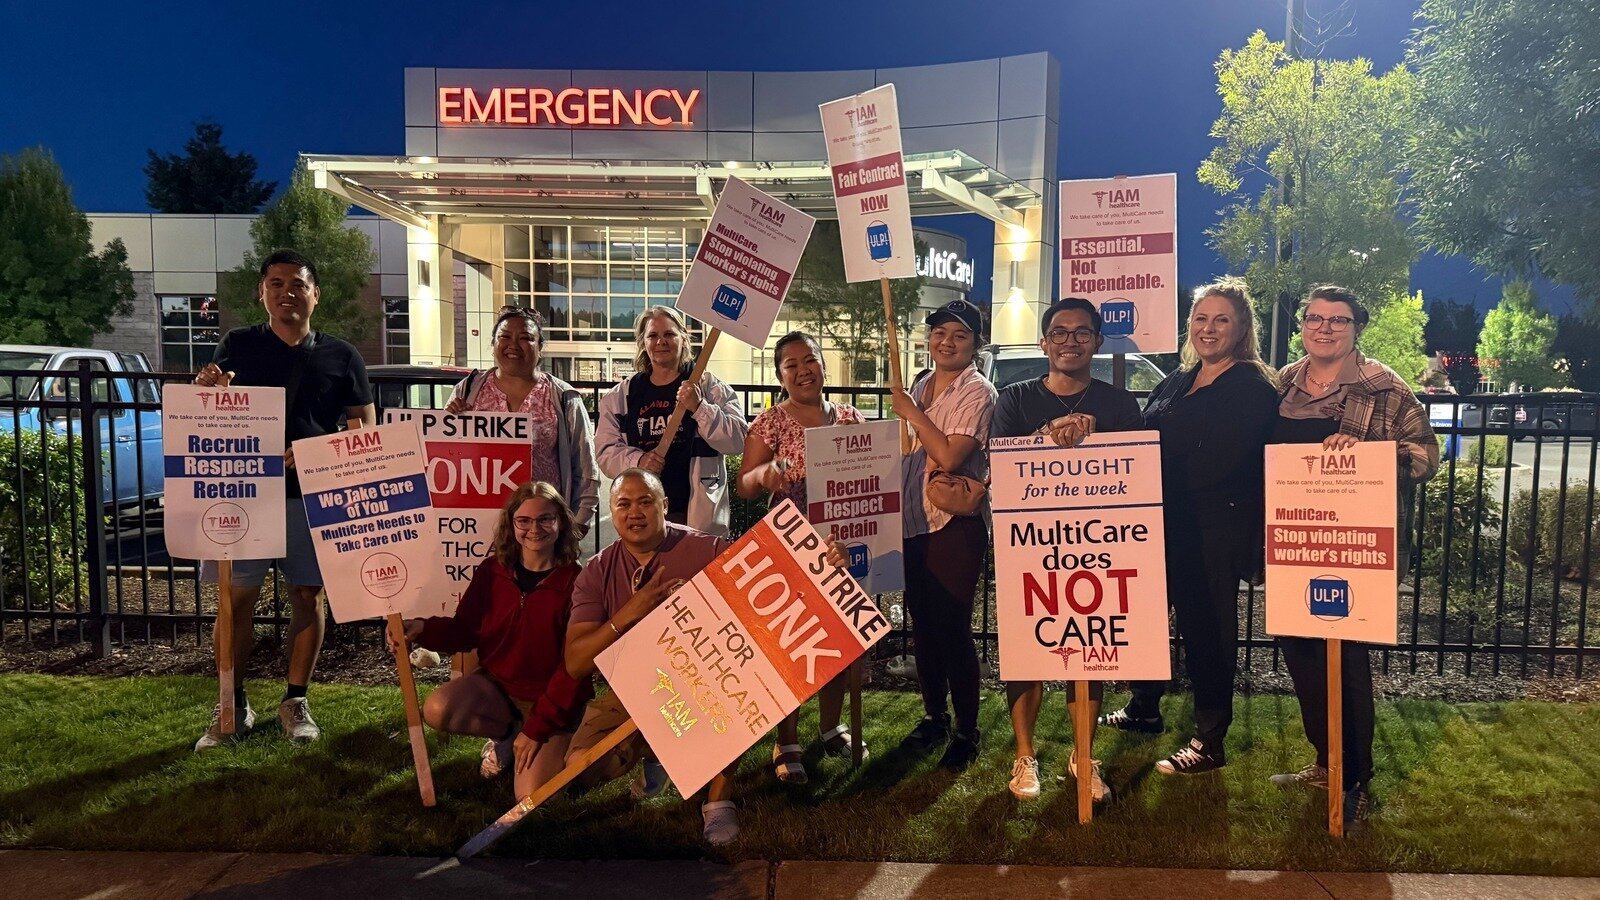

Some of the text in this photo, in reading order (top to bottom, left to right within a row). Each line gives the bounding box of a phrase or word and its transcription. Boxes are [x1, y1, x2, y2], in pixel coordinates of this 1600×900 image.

[439, 87, 700, 126] EMERGENCY
[856, 103, 877, 121] IAM
[837, 162, 900, 189] Fair Contract
[860, 194, 888, 212] NOW
[1109, 188, 1140, 203] IAM
[760, 203, 786, 223] IAM
[715, 222, 759, 253] MultiCare,
[869, 233, 888, 247] ULP!
[1070, 236, 1145, 255] Essential,
[708, 236, 778, 281] Stop violating
[916, 247, 971, 285] ultiCare
[1070, 259, 1097, 276] Not
[703, 250, 779, 296] worker's rights
[1070, 273, 1165, 294] Expendable.
[718, 291, 741, 311] ULP!
[1103, 310, 1131, 323] ULP!
[215, 392, 249, 405] IAM
[442, 414, 528, 438] STRIKE
[649, 414, 672, 430] IA
[188, 435, 260, 453] Recruit
[345, 431, 381, 450] IAM
[846, 433, 872, 448] IAM
[990, 438, 1031, 446] MultiCare
[348, 446, 383, 457] healthcare
[365, 453, 395, 464] MultiCare
[396, 450, 415, 458] needs
[1320, 454, 1356, 469] IAM
[184, 457, 265, 476] Respect
[426, 457, 523, 496] ONK
[1014, 457, 1135, 478] THOUGHT
[1320, 468, 1356, 476] healthcare
[194, 481, 256, 498] Retain
[318, 480, 414, 508] We Take Care
[826, 474, 881, 498] Recruit
[1021, 480, 1128, 501] for the week
[346, 500, 389, 518] of You
[823, 495, 884, 520] Respect
[1275, 507, 1340, 523] MultiCare,
[219, 516, 240, 524] IAM
[321, 513, 425, 541] MultiCare Needs to
[438, 517, 477, 534] FOR
[830, 519, 878, 541] Retain
[335, 529, 419, 554] Take Care of Us
[1010, 519, 1149, 547] MultiCare
[1273, 527, 1377, 548] Stop violating
[850, 552, 865, 567] LP!
[1042, 546, 1112, 571] does
[1273, 546, 1388, 565] worker's rights
[375, 565, 398, 577] IAM
[772, 503, 887, 642] ULP STRIKE
[1022, 568, 1138, 617] NOT
[1313, 588, 1345, 603] ULP!
[722, 539, 842, 685] HONK
[1034, 615, 1129, 647] CARE
[716, 620, 755, 668] FOR
[1082, 646, 1118, 662] IAM
[664, 595, 771, 736] HEALTHCARE
[1083, 663, 1119, 671] healthcare
[656, 626, 734, 734] WORKERS
[666, 692, 698, 731] IAM
